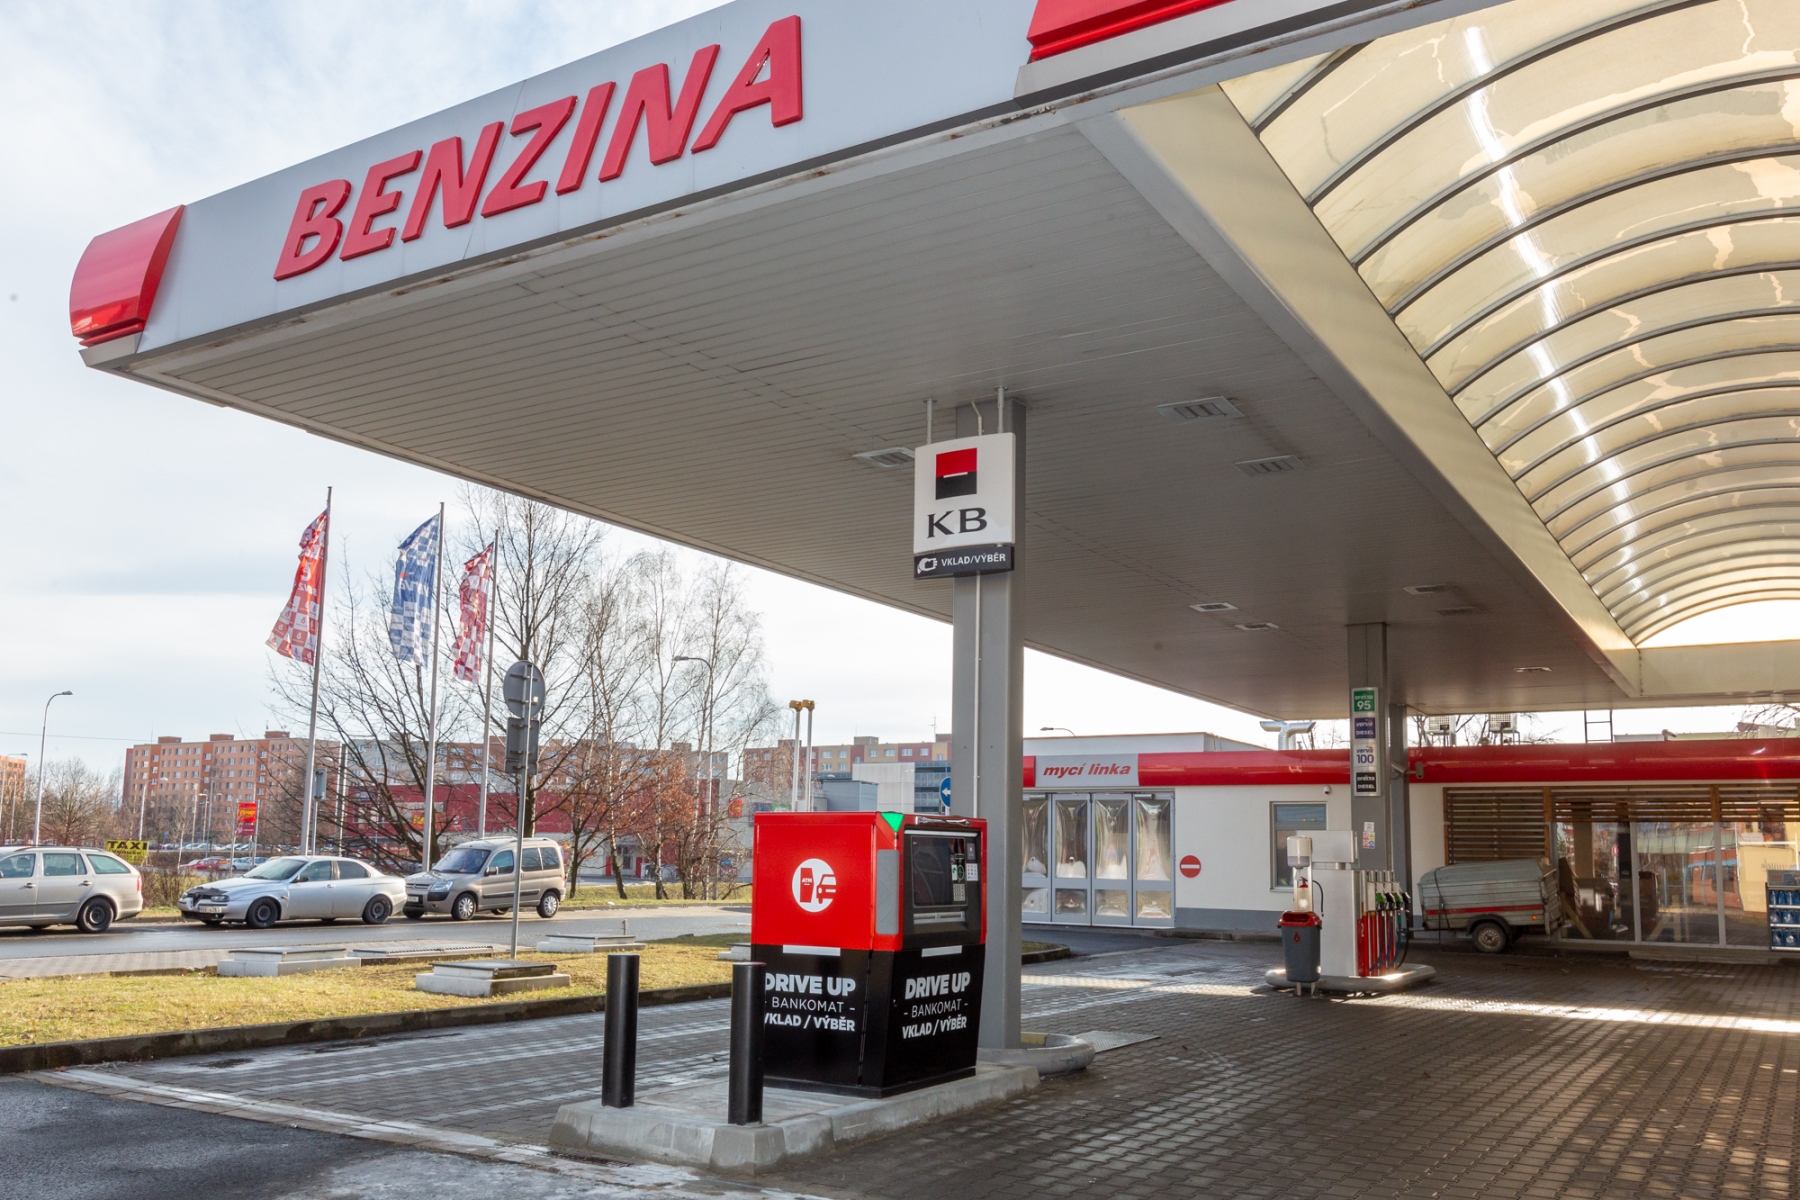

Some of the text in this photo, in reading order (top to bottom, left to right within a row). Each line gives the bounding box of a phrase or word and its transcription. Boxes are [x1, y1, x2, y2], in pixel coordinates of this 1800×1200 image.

[273, 15, 803, 281] BENZINA
[927, 507, 987, 539] KB
[941, 553, 1006, 567] VKLAD/VÝBĚR
[1357, 700, 1371, 711] 95
[1356, 754, 1375, 764] 100
[1043, 763, 1131, 779] mycí linka
[107, 841, 148, 850] TAXI
[765, 972, 856, 996] DRIVE UP
[905, 971, 971, 1000] DRIVE UP
[772, 996, 844, 1013] BANKOMAT
[911, 998, 962, 1018] BANKOMAT
[813, 1015, 856, 1032] VÝBĚR
[902, 1022, 932, 1039] VKLAD
[940, 1013, 967, 1033] VÝBĚR
